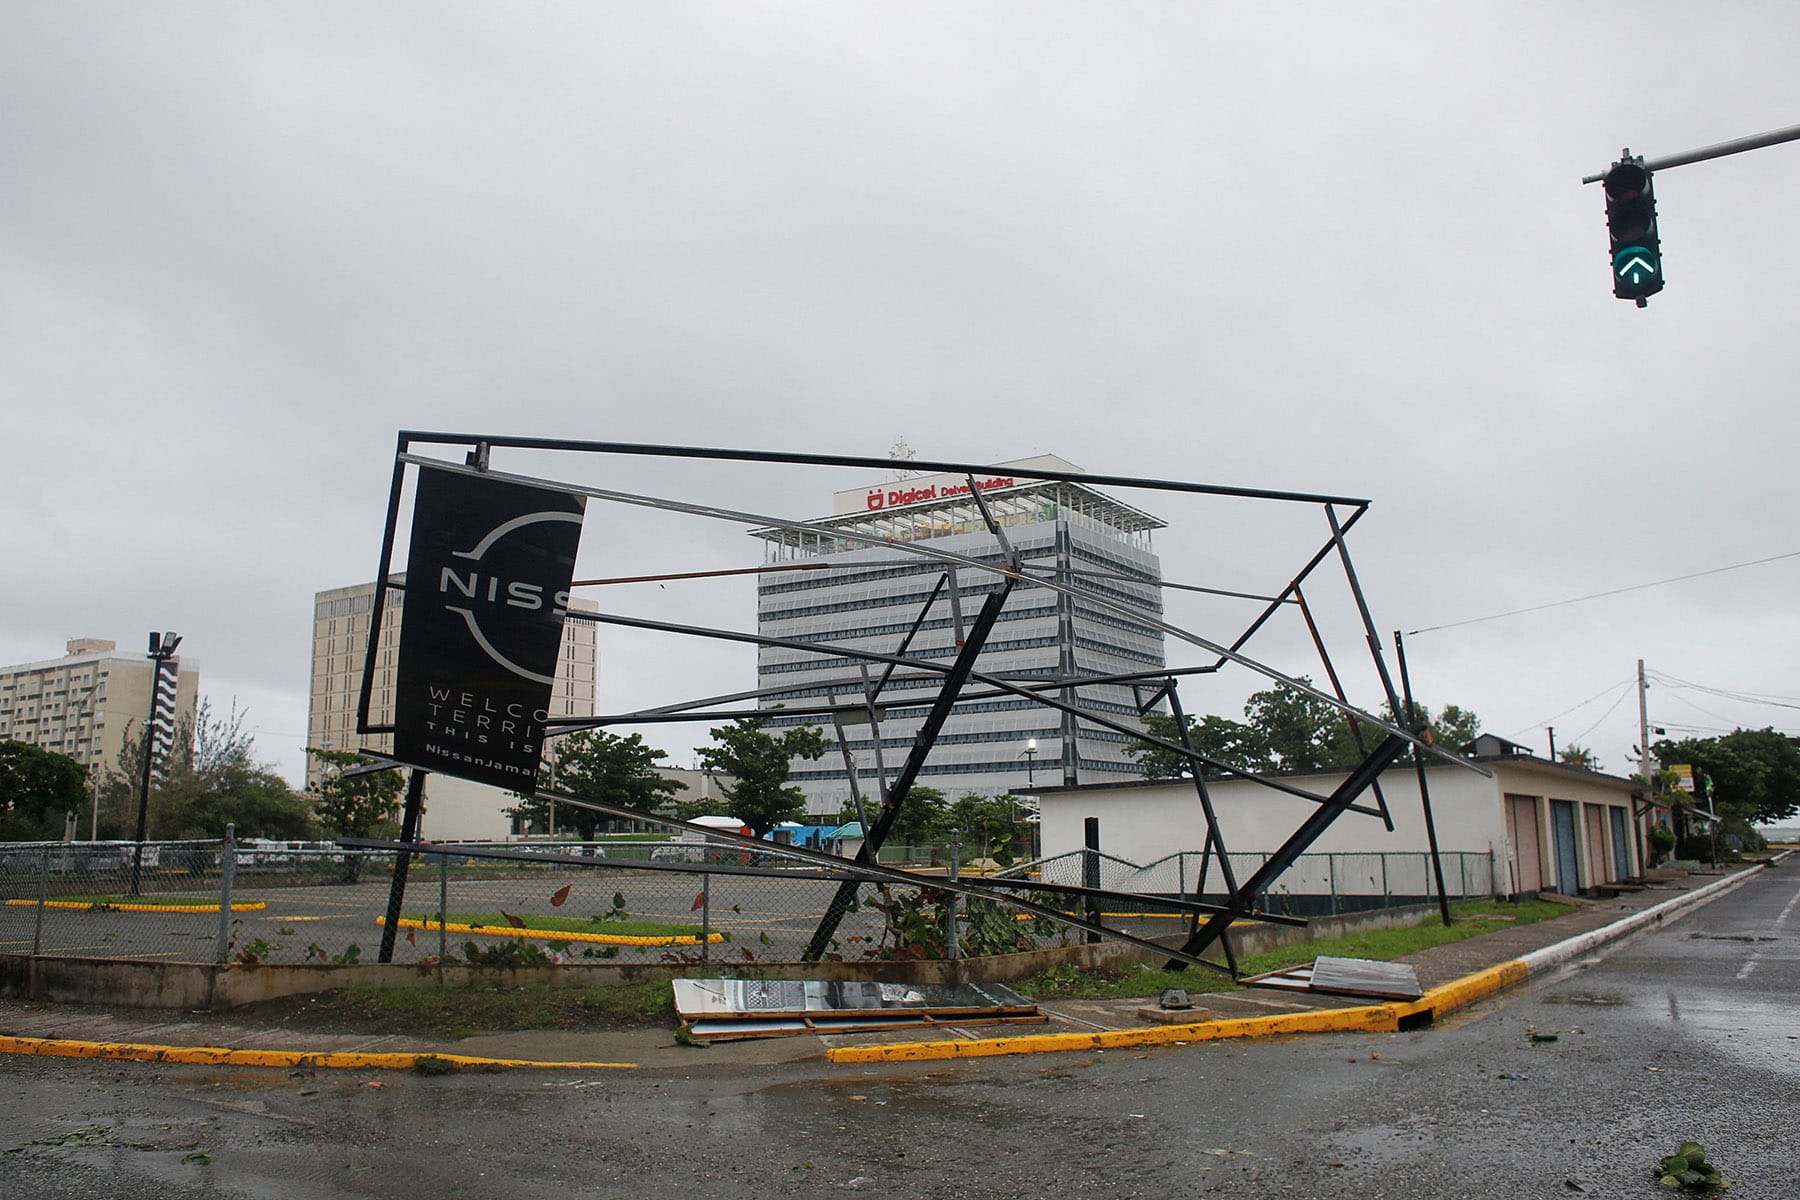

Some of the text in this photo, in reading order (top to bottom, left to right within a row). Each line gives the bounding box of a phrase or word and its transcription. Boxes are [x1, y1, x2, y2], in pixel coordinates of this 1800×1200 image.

[888, 484, 936, 505] Digicel
[428, 702, 545, 738] TERRI
[430, 685, 548, 723] WELCO
[426, 721, 533, 753] THIS IS
[426, 743, 537, 777] NissanJamai
